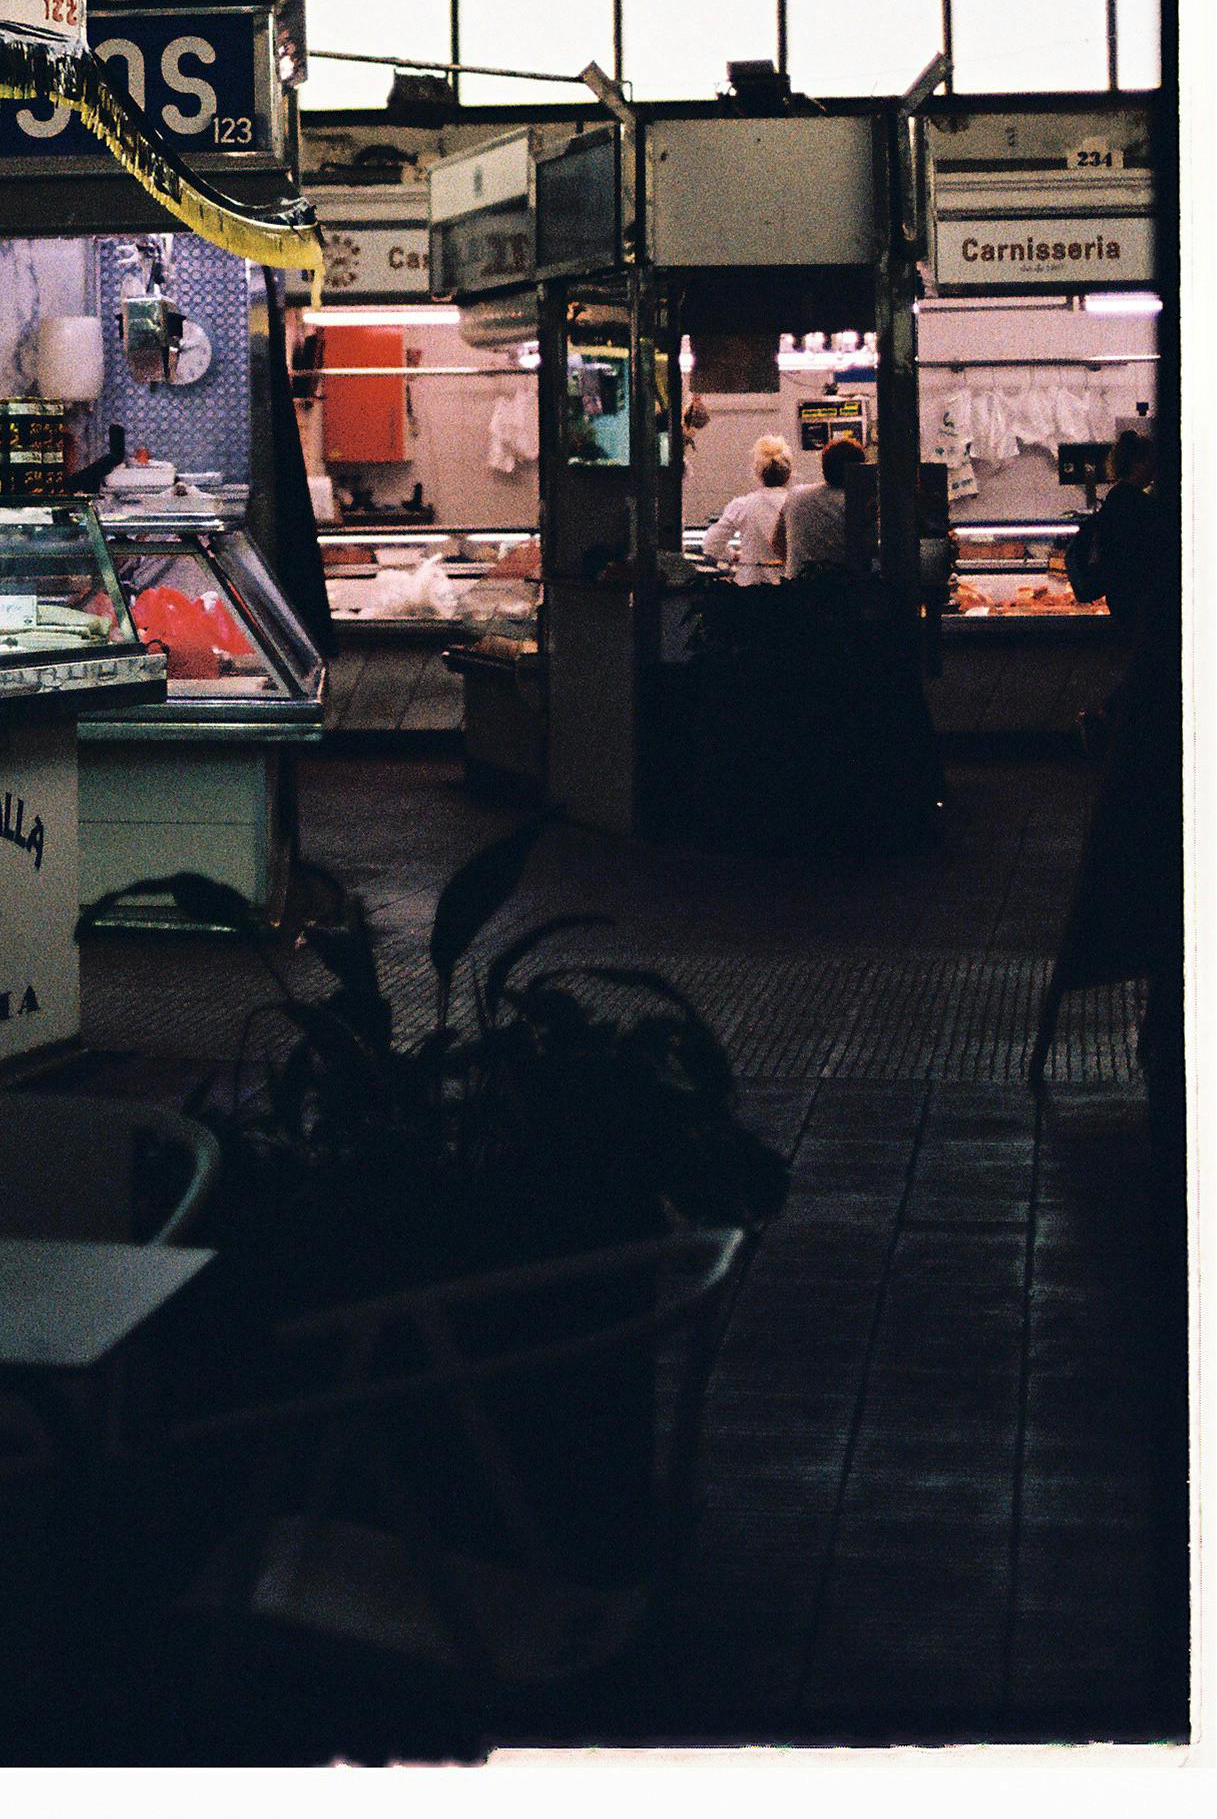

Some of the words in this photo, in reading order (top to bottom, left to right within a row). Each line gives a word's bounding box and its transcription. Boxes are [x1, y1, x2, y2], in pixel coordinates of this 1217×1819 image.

[213, 118, 252, 144] 123
[1077, 151, 1113, 168] 234
[962, 235, 1121, 263] Carnisseria
